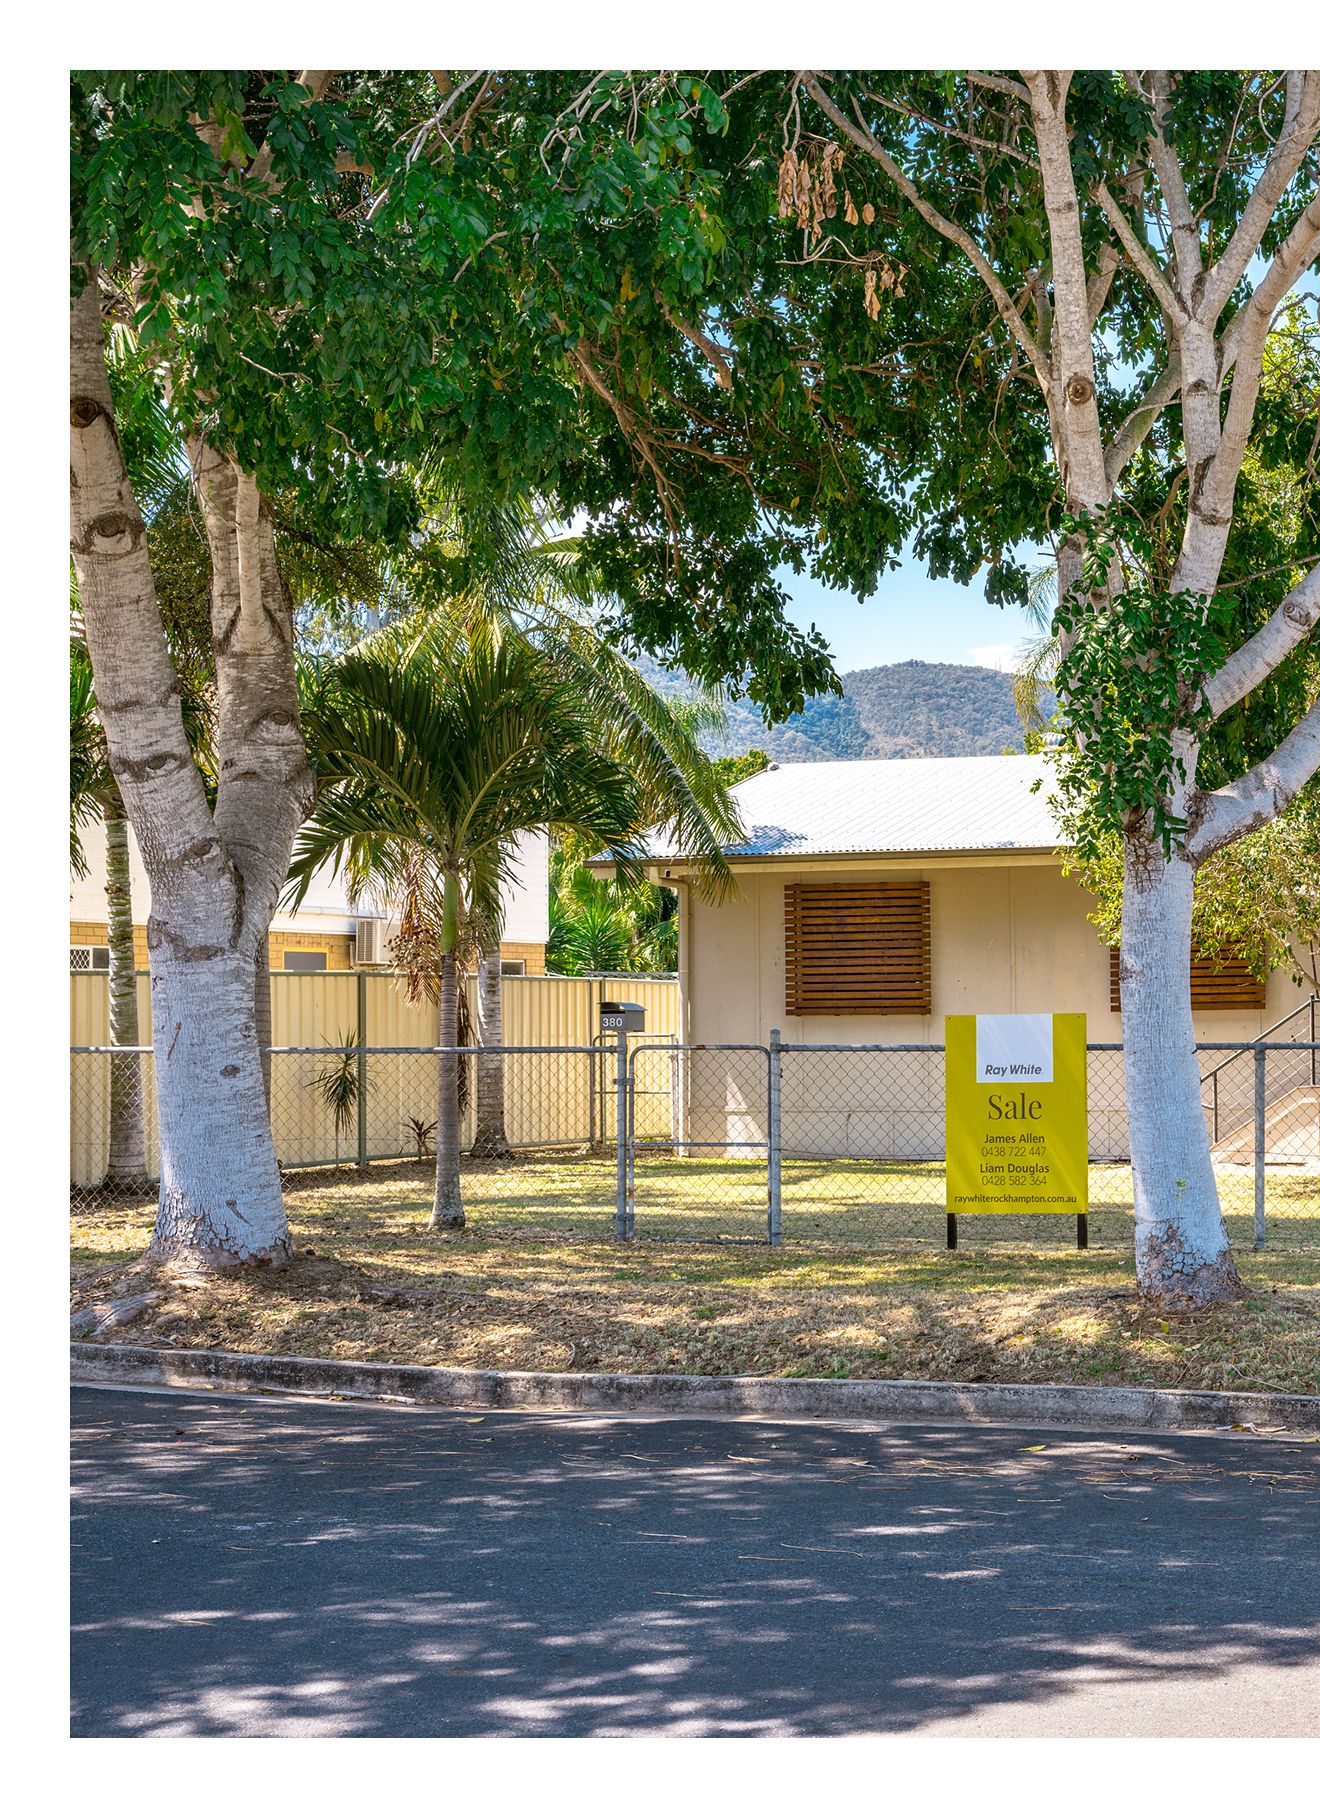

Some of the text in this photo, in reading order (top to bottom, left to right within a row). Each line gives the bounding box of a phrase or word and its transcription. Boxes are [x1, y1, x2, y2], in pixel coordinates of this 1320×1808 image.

[602, 1017, 623, 1027] 380
[985, 1064, 1042, 1077] Ray White
[988, 1092, 1043, 1121] Sale
[984, 1132, 1045, 1144] James Allen
[981, 1146, 1047, 1157] 0438 722 447
[980, 1162, 1050, 1175] Liam Douglas
[981, 1175, 1047, 1186] 0428 582 364
[954, 1194, 1077, 1204] raywhiterockhampton.com.au
